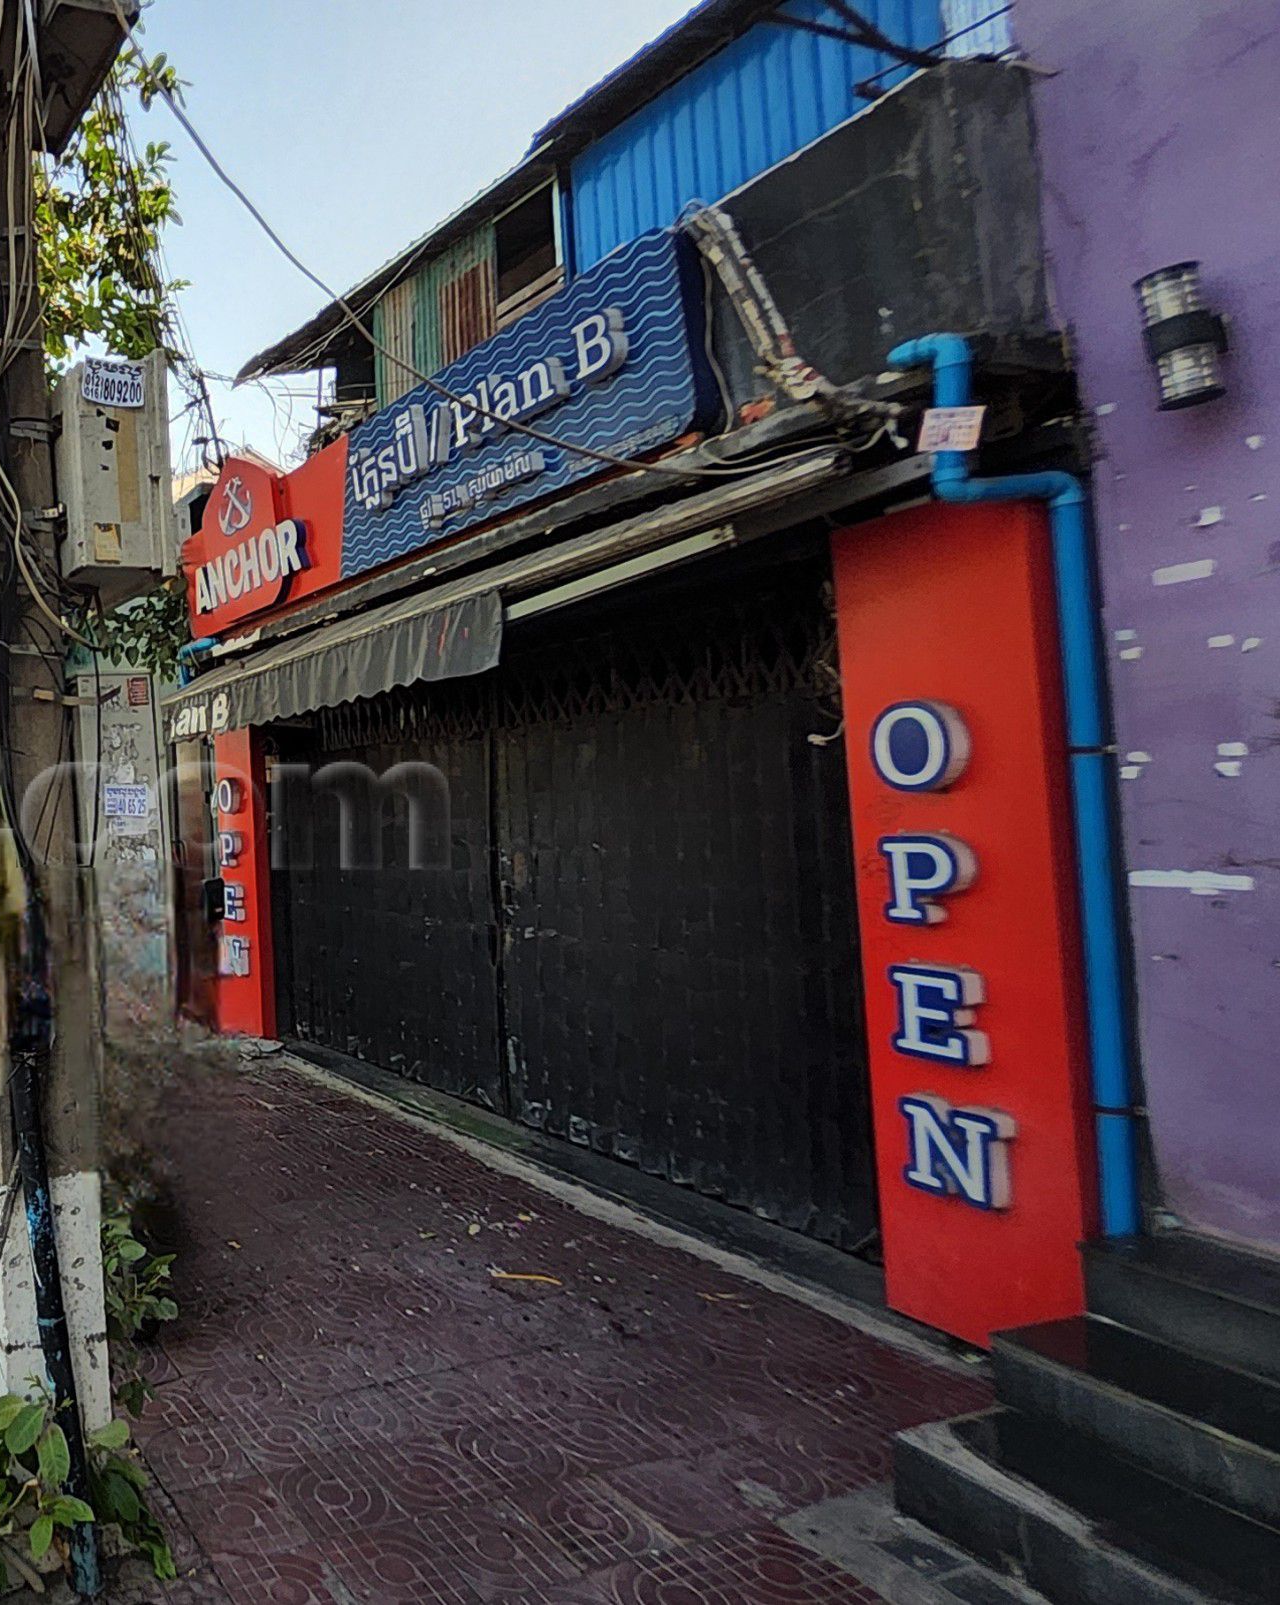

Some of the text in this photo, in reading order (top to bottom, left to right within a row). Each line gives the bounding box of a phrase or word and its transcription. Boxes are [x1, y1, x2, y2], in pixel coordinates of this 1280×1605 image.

[84, 373, 101, 388] 012
[103, 378, 142, 404] 809200
[449, 361, 556, 449] Plan
[570, 314, 616, 381] B
[194, 519, 304, 616] ANCHOR
[870, 699, 1006, 1212] OPEN
